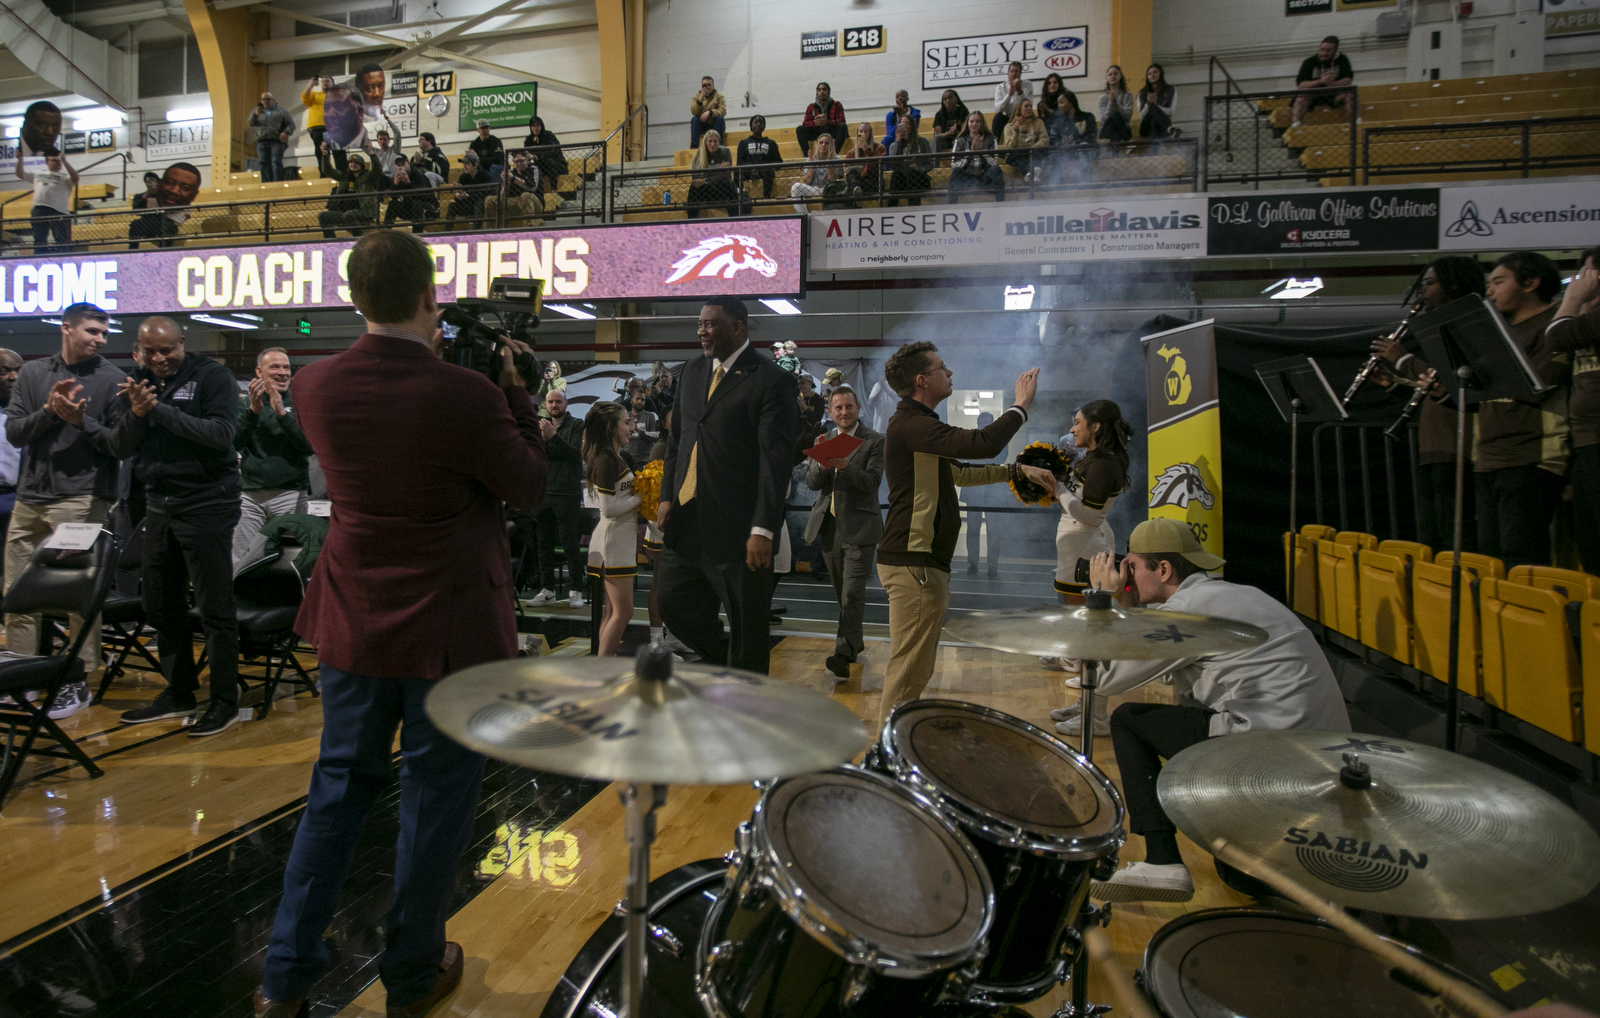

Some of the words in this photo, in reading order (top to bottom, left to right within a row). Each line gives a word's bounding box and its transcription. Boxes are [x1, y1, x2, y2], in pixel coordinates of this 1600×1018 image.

[803, 36, 836, 46] STUDENT
[847, 28, 880, 49] 218
[1051, 37, 1076, 50] Ford
[803, 43, 835, 53] SECTION
[926, 39, 1039, 70] SEELYE
[1051, 56, 1075, 67] KIA
[933, 64, 1030, 79] KALAMAZO
[392, 76, 418, 84] STUDENT
[392, 83, 417, 91] SECTION
[425, 74, 451, 92] 217
[473, 90, 533, 108] BRONSON
[473, 108, 490, 116] Sports
[491, 105, 516, 114] Medicine
[91, 131, 112, 147] 216
[148, 125, 210, 146] SEELYE
[150, 147, 178, 155] BATTLE
[183, 144, 207, 152] CREEK
[1257, 200, 1316, 228] Gallivan
[1320, 198, 1364, 226] Office
[1369, 196, 1437, 220] Solutions
[1491, 204, 1600, 225] Ascension
[1043, 234, 1106, 243] EXPERIENCE
[1111, 232, 1160, 241] MATTERS
[1302, 229, 1350, 240] KYOCERA
[826, 241, 868, 250] HEATING
[873, 240, 879, 248] &
[883, 240, 900, 248] AIR
[904, 236, 983, 248] CONDITIONING
[1005, 246, 1037, 256] General
[1038, 244, 1086, 254] Contractors
[1101, 243, 1155, 253] Construction
[1156, 241, 1200, 252] Managers
[867, 254, 909, 264] neighborly
[910, 253, 946, 262] company
[177, 250, 323, 308] COACH
[499, 688, 640, 740] SABIAN
[1284, 827, 1428, 870] SABIAN
